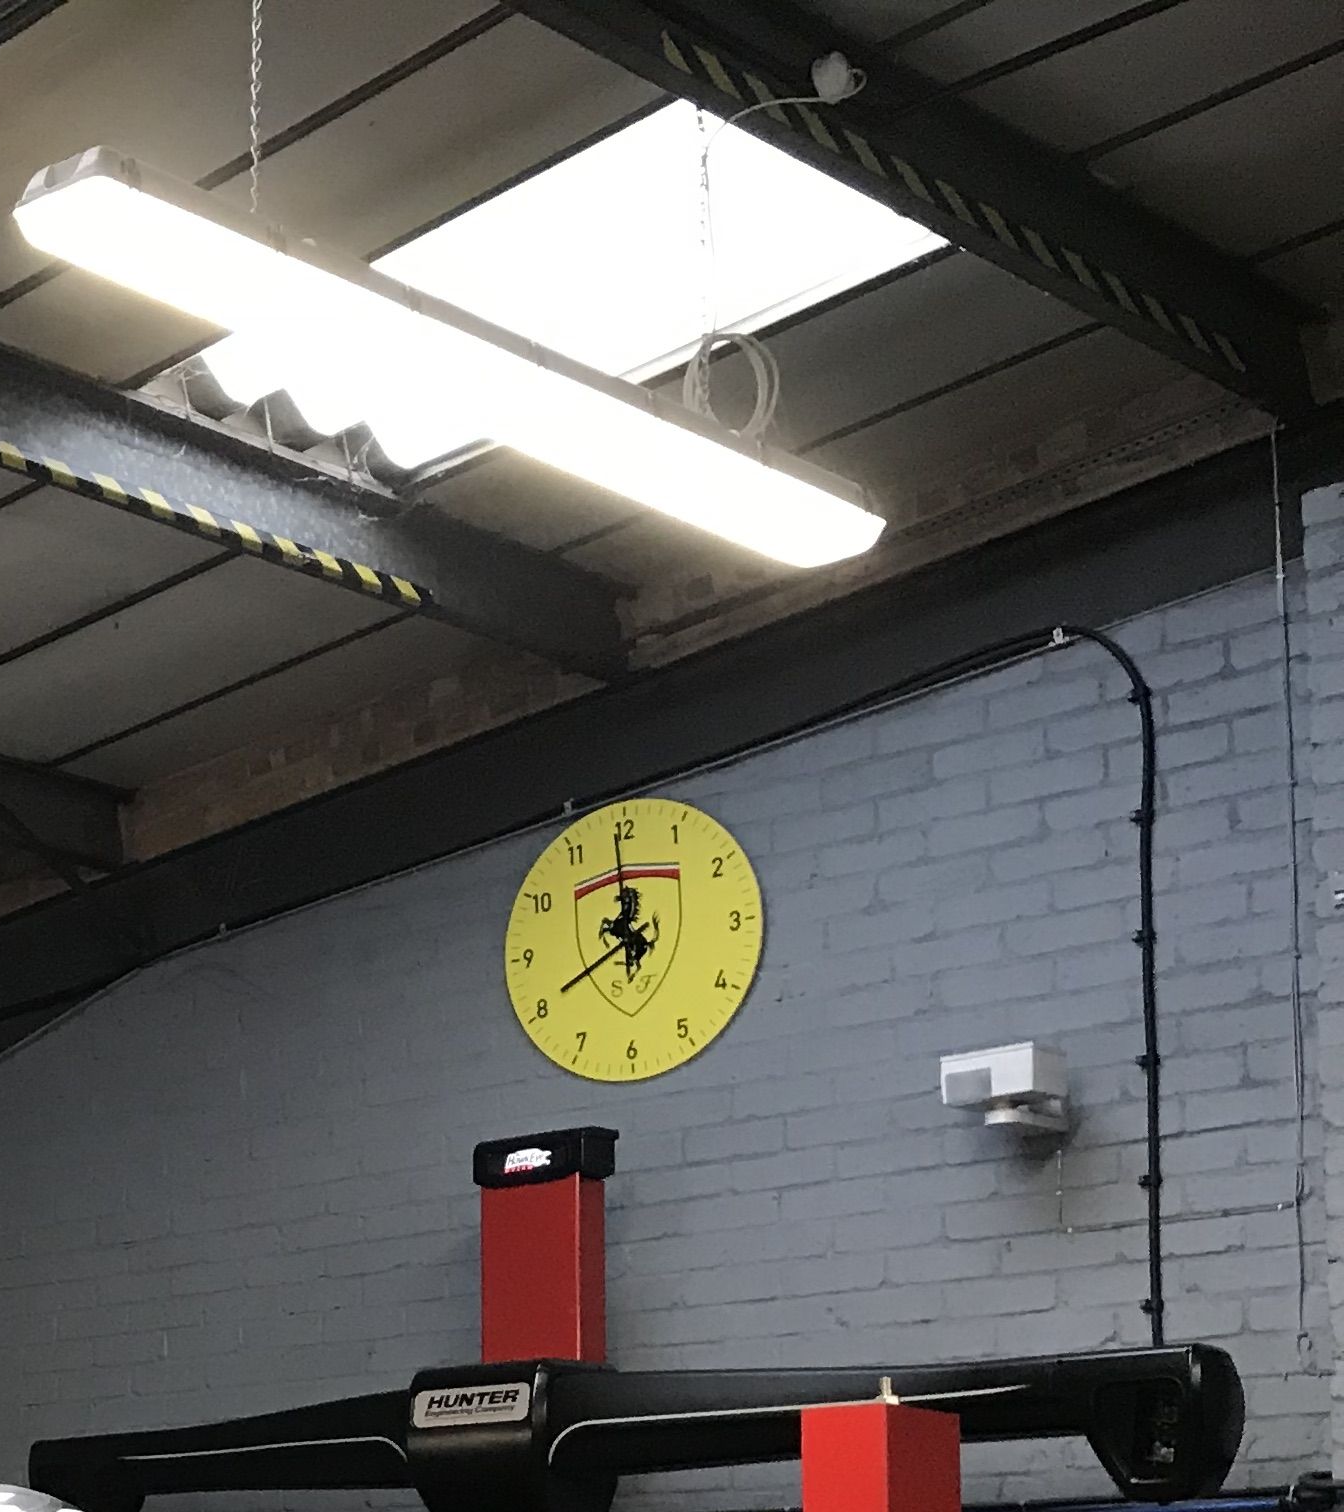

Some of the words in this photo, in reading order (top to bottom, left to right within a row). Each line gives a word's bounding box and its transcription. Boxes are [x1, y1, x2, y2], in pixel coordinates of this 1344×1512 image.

[615, 820, 635, 840] 12
[671, 825, 679, 843] 1
[568, 844, 584, 865] 11
[711, 857, 724, 878] 2
[532, 893, 552, 913] 10
[729, 911, 741, 931] 3
[523, 949, 534, 968] 9
[715, 970, 727, 990] 4
[536, 999, 548, 1020] 8
[677, 1018, 689, 1039] 5
[575, 1032, 587, 1052] 7
[627, 1040, 638, 1060] 6
[427, 1389, 519, 1409] HUNTER
